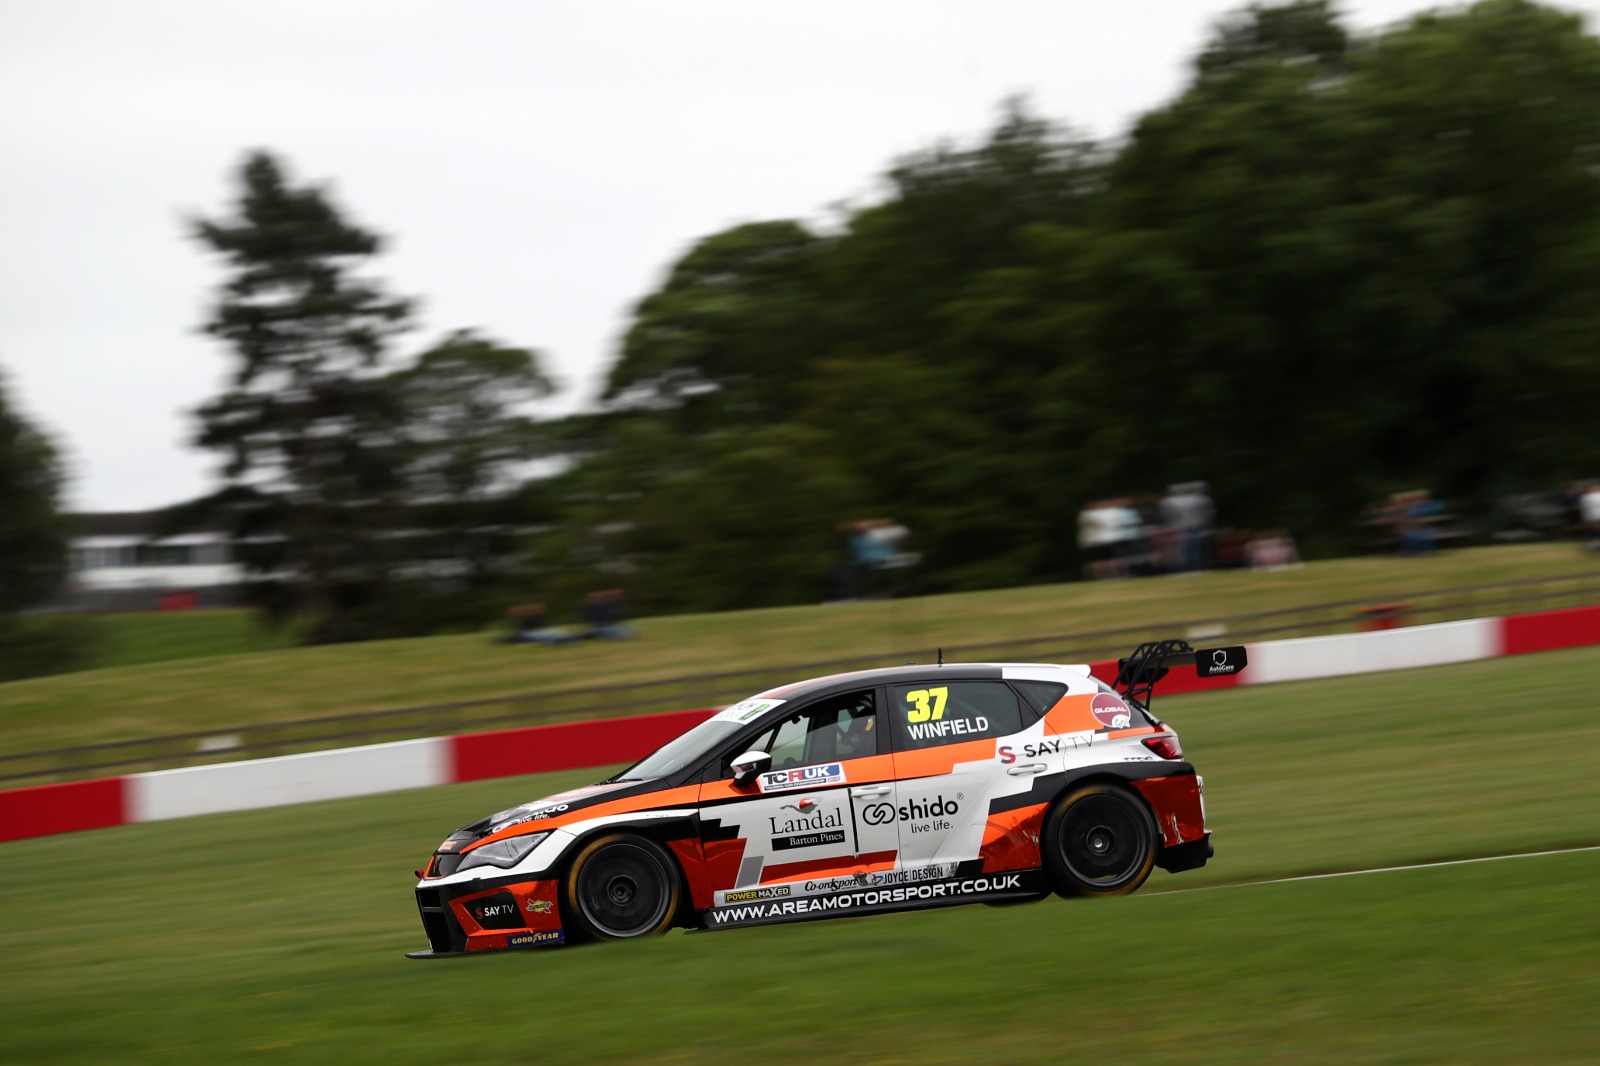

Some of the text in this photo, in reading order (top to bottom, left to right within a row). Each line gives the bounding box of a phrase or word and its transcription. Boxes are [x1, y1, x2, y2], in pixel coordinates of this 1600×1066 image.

[906, 686, 948, 723] 37
[1094, 706, 1128, 714] GLOBAL
[907, 716, 989, 740] WINFIELD
[1023, 739, 1061, 758] SAY
[1067, 734, 1093, 749] TV
[898, 795, 959, 821] shido
[769, 807, 843, 834] Landal
[911, 820, 953, 834] live life.
[789, 833, 843, 846] Barton Pines
[713, 875, 1021, 923] WWW.AREAMOTORSPORT.CO.UK
[726, 891, 757, 901] POWER
[484, 905, 500, 917] SAY
[502, 904, 514, 914] TV
